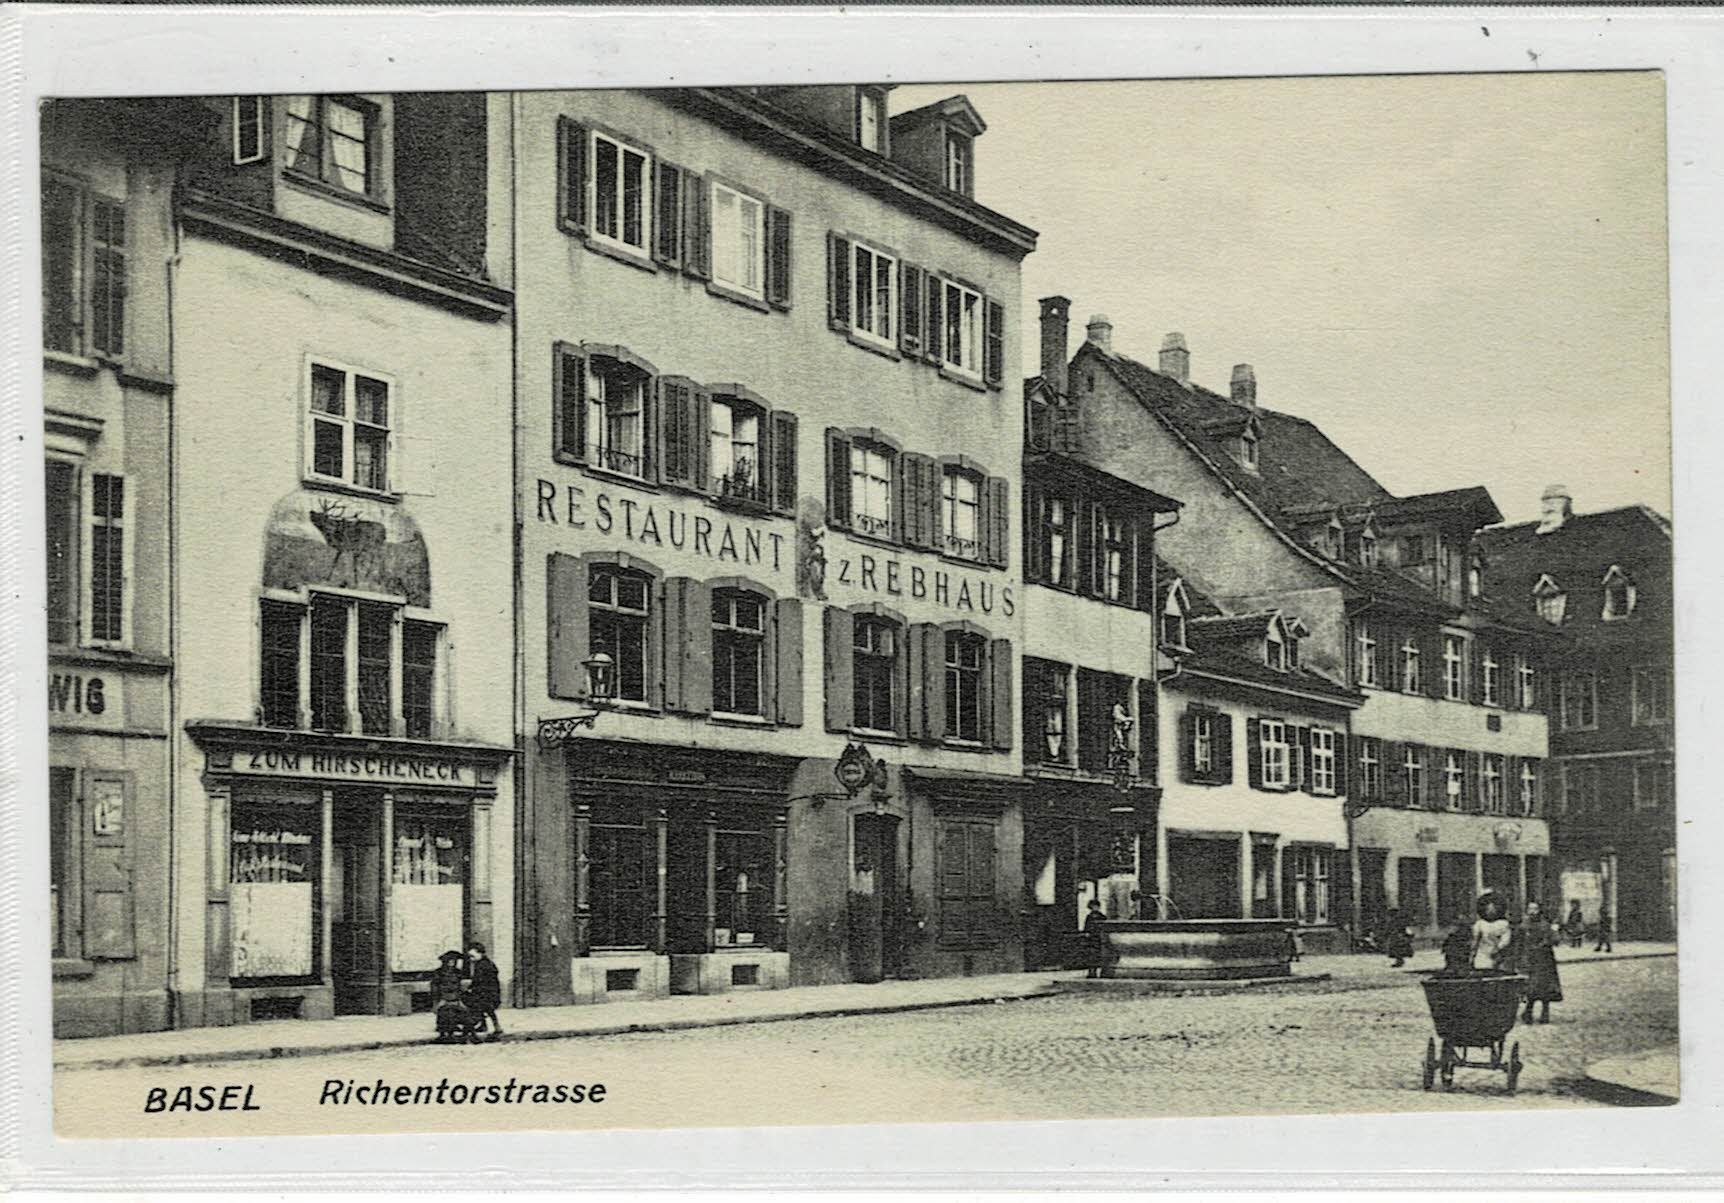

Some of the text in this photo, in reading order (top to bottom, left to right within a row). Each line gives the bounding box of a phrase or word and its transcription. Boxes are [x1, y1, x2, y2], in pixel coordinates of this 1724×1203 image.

[537, 478, 785, 572] RESTAURANT
[249, 752, 462, 782] ZUM HIRSCHENECK
